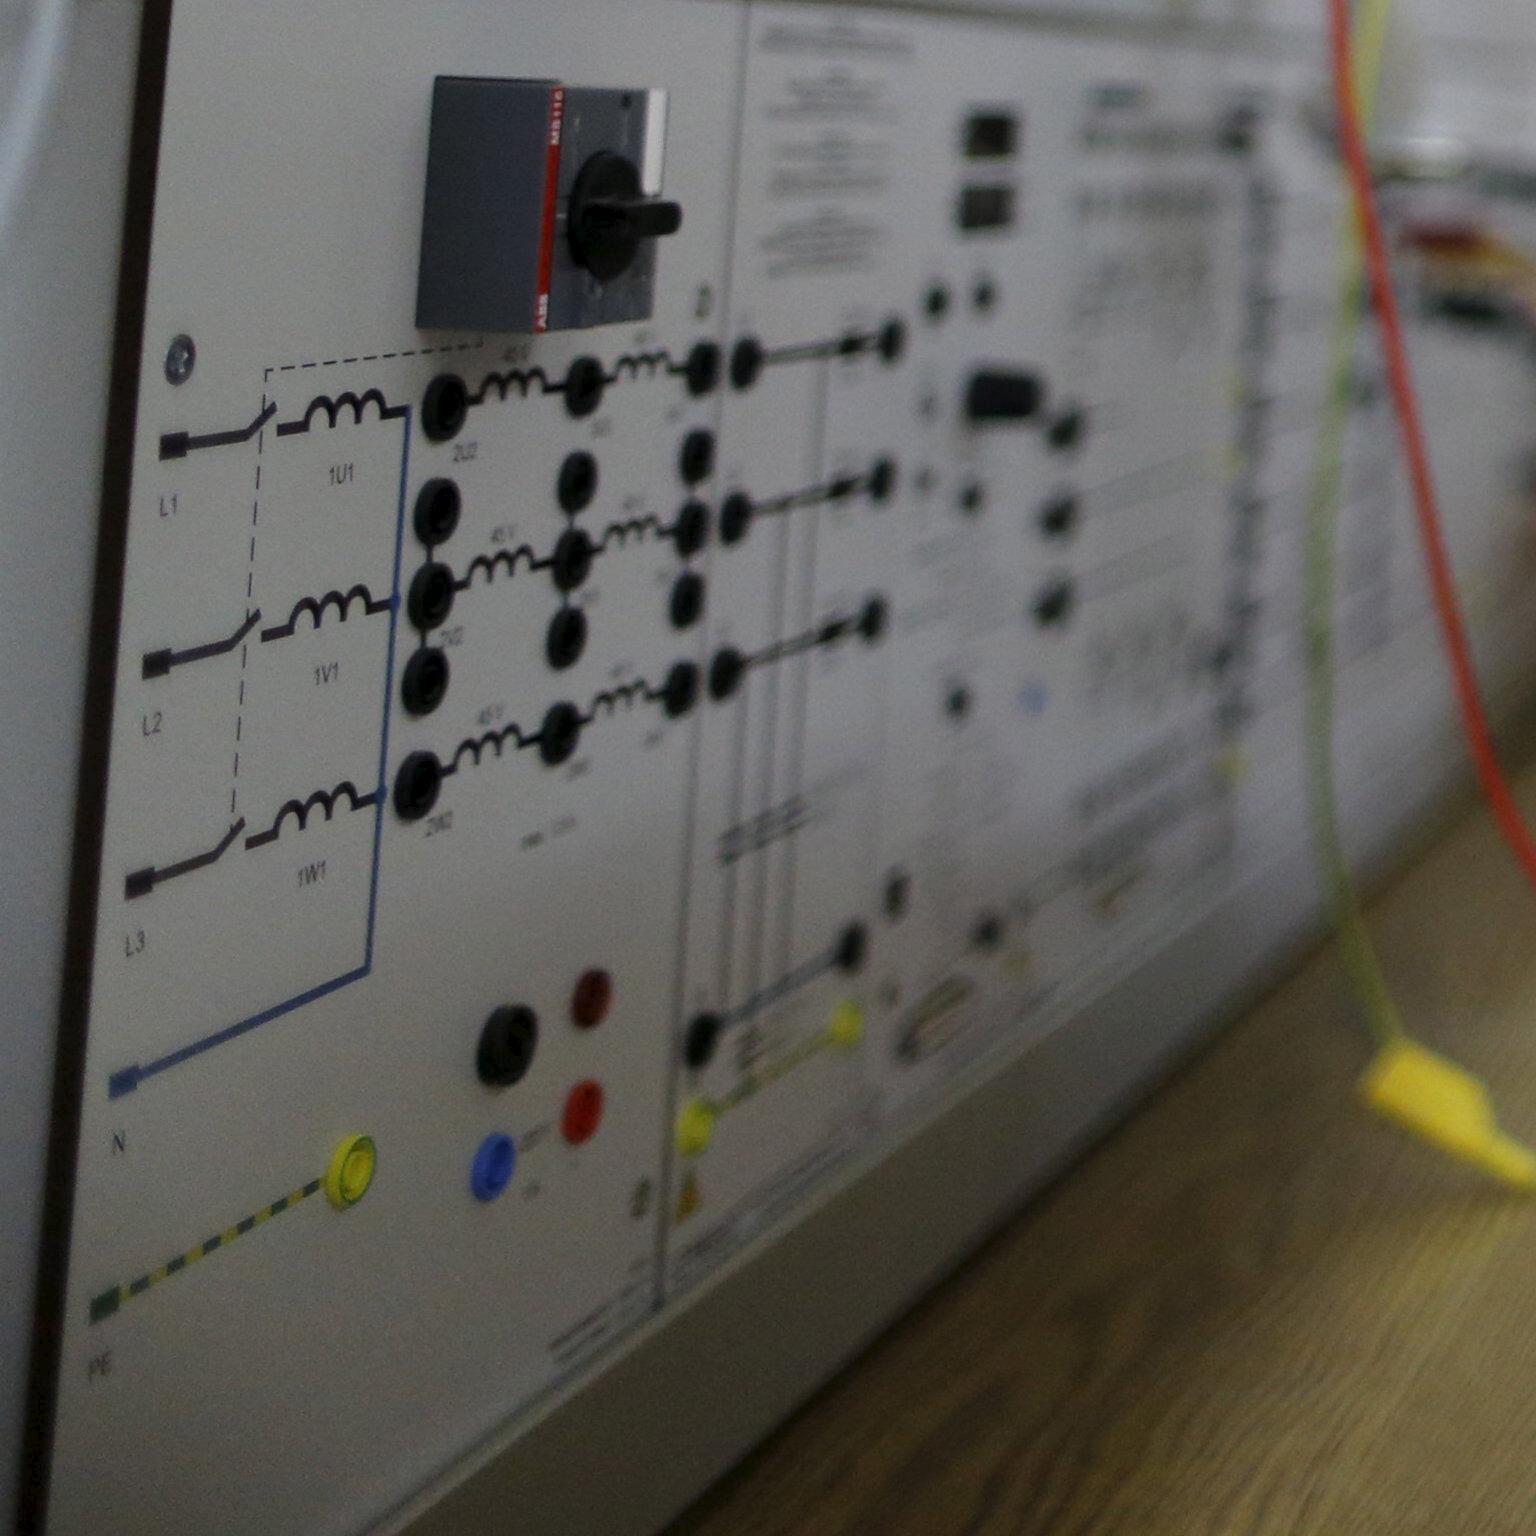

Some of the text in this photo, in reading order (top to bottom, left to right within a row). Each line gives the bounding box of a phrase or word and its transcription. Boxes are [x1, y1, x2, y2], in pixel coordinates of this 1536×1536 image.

[534, 292, 550, 330] ABB
[329, 462, 355, 486] 1U1
[159, 494, 178, 518] L1
[314, 661, 339, 686] 1V1
[142, 711, 163, 737] L2
[297, 859, 327, 888] 1W1
[125, 928, 146, 957] L3
[112, 1129, 127, 1156] N
[87, 1349, 114, 1385] PE
